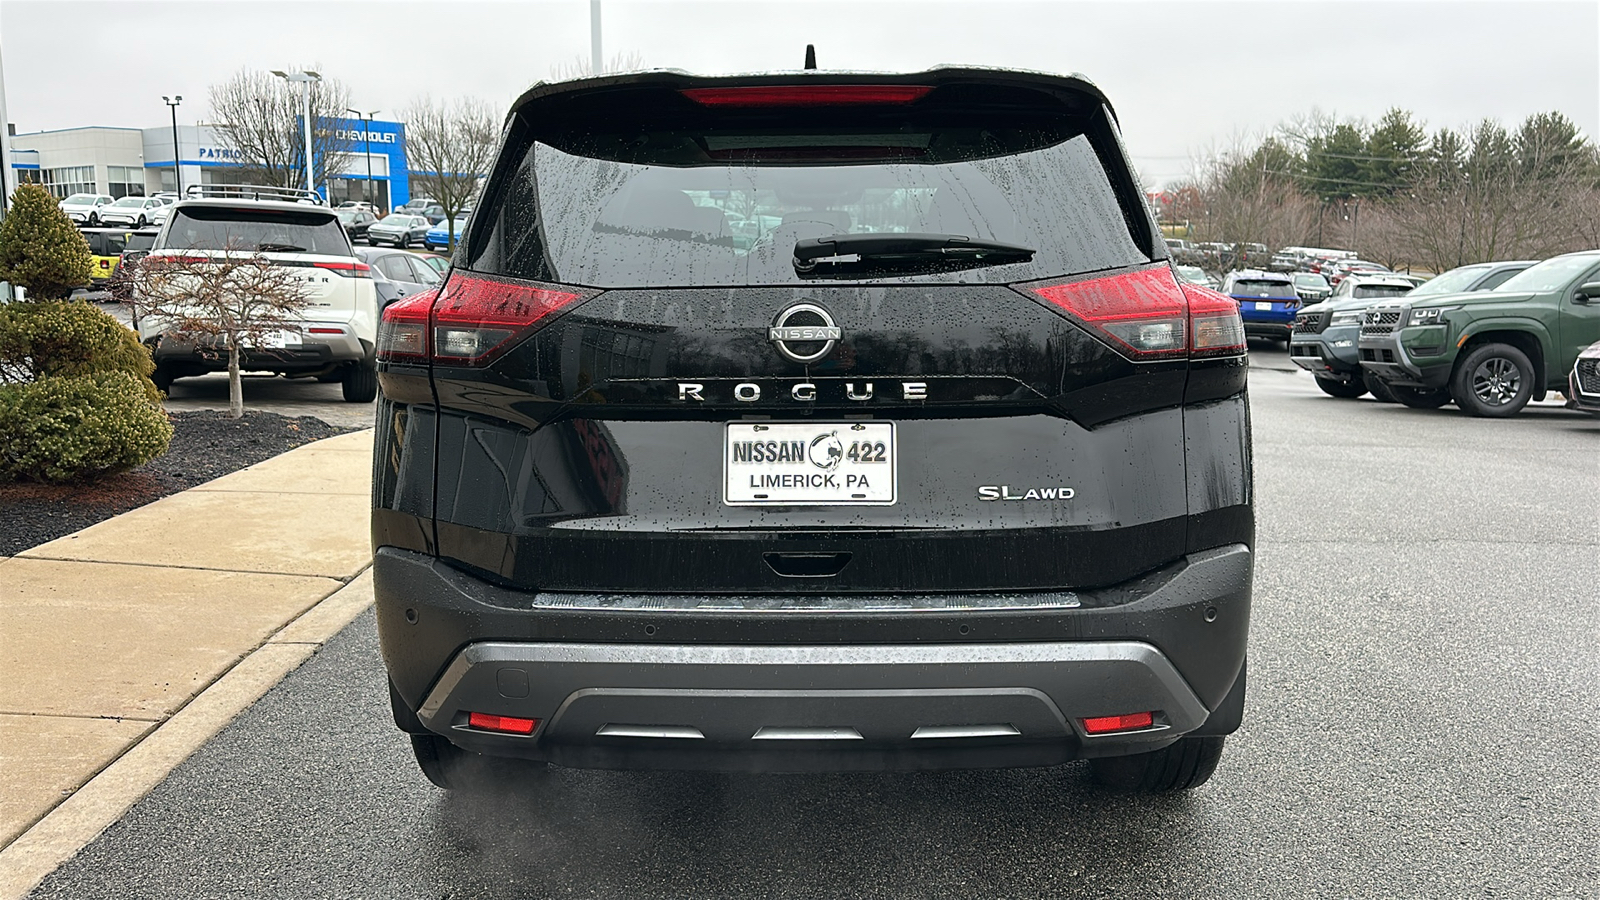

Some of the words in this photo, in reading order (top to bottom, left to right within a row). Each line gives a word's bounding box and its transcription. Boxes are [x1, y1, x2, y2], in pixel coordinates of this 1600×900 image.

[335, 129, 397, 144] CHEVROLET
[199, 148, 243, 159] PATRIO
[770, 328, 840, 340] NISSAN
[677, 382, 928, 402] ROGUE
[732, 441, 805, 464] NISSAN
[846, 441, 887, 464] 422
[750, 474, 841, 489] LIMERICK,
[846, 474, 870, 488] PA
